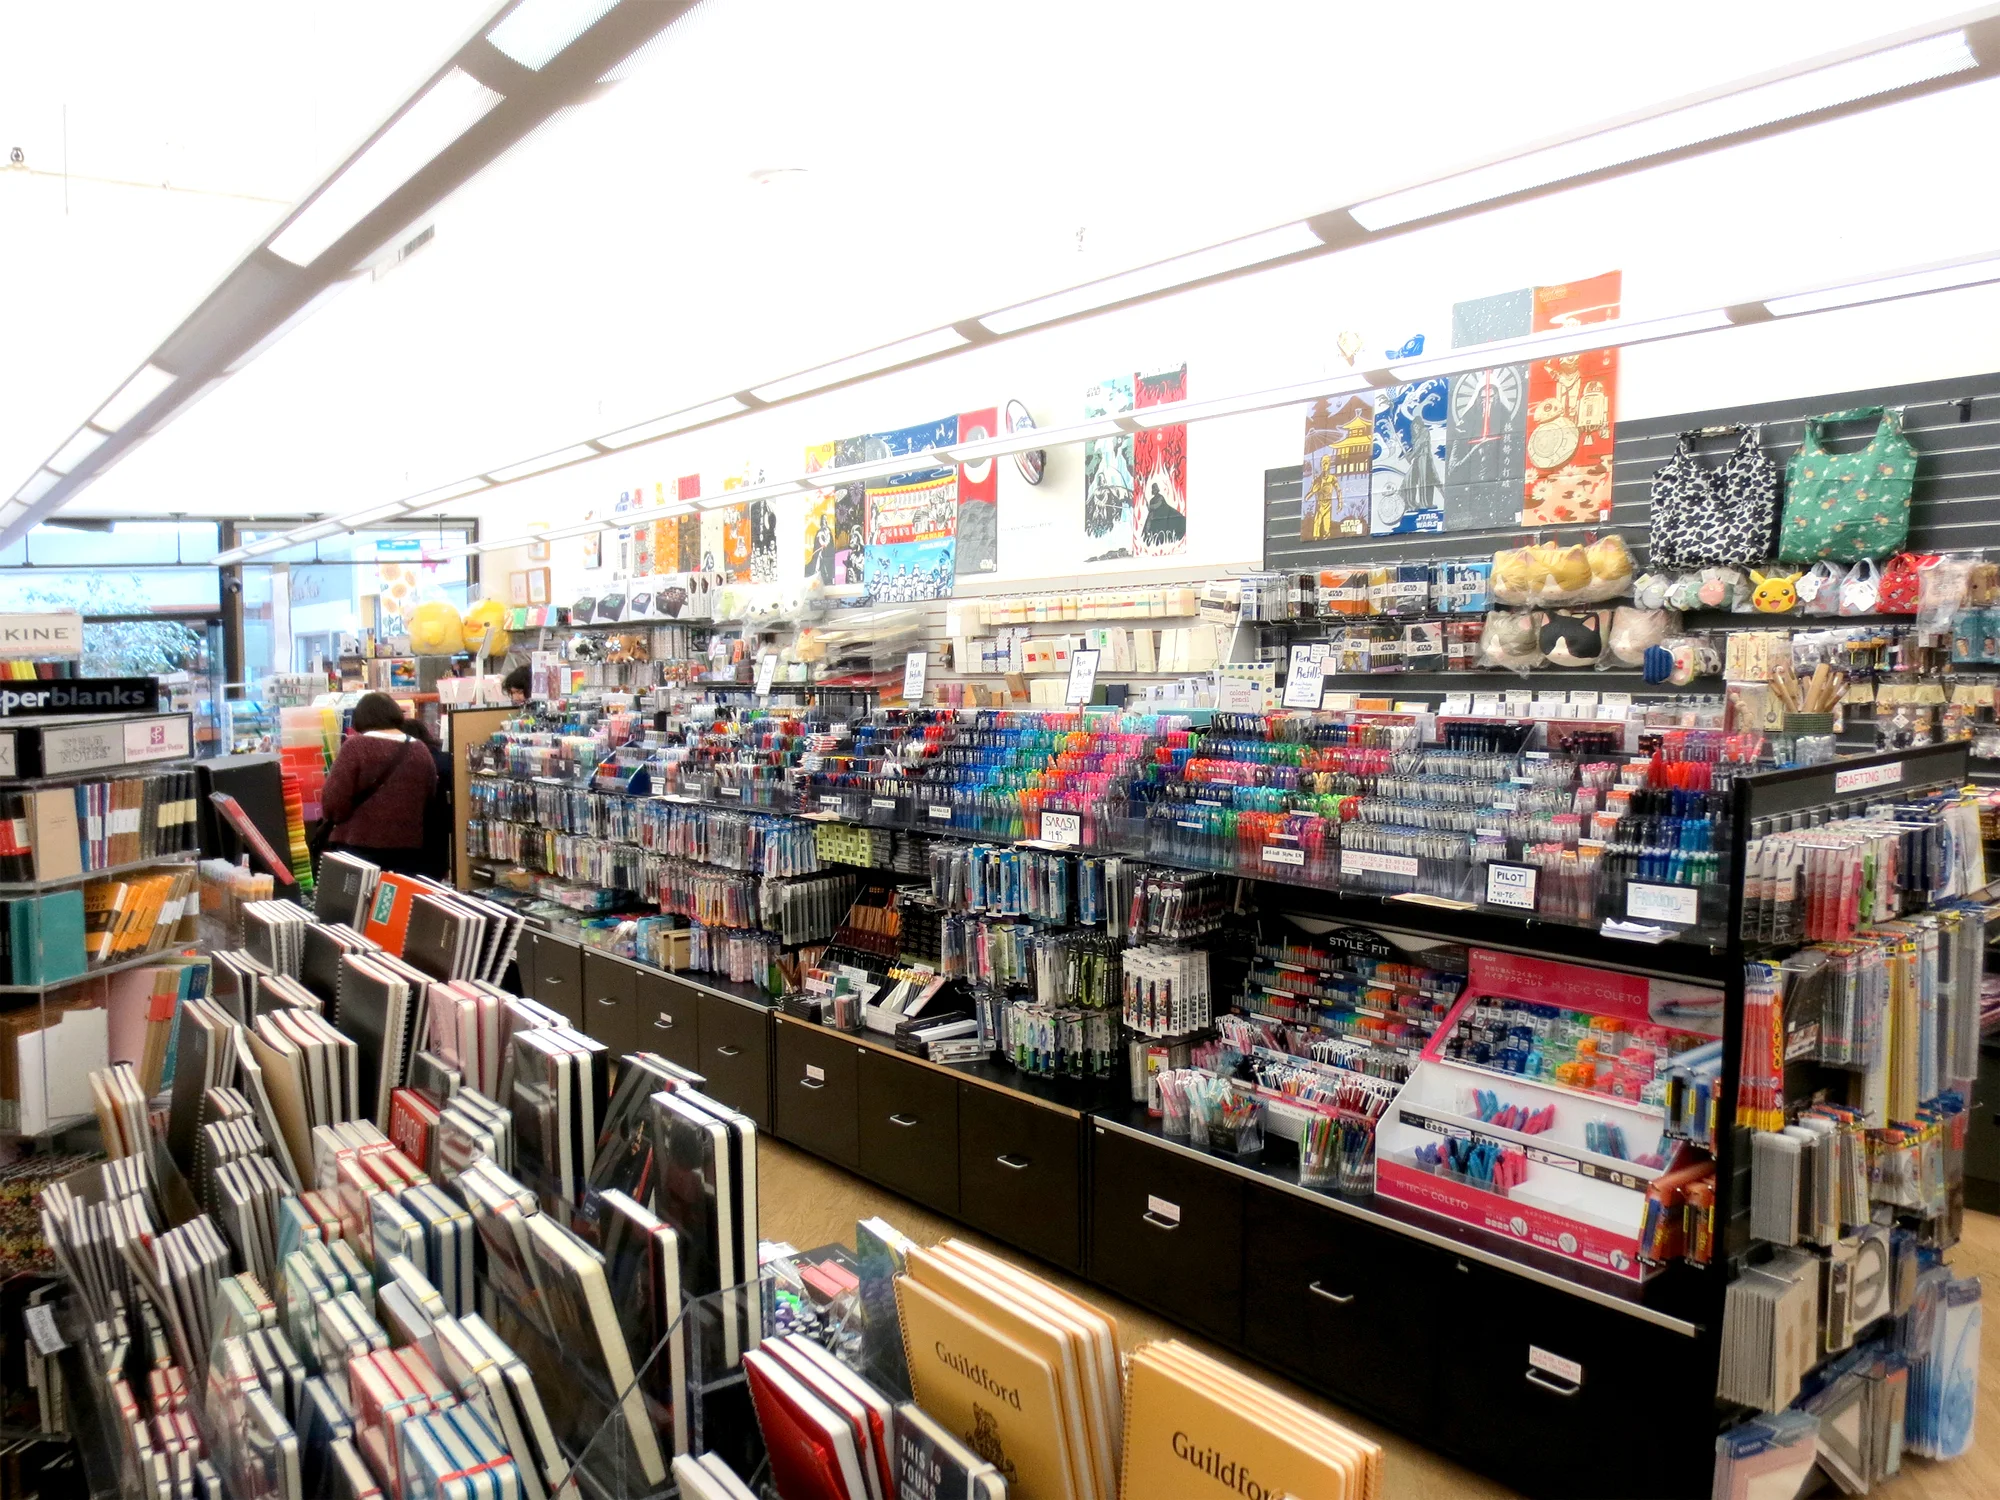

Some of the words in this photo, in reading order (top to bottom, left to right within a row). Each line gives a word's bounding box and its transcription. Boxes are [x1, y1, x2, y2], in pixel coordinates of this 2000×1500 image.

[1416, 513, 1439, 521] STAR
[1340, 525, 1358, 533] WAR
[0, 627, 69, 641] KINE
[1295, 650, 1310, 663] Pen
[0, 685, 145, 715] perblanks
[1837, 770, 1880, 788] DRAFTING
[1045, 815, 1077, 829] SARASA
[1497, 871, 1524, 882] PILOT
[1329, 936, 1364, 951] STYLE
[1371, 944, 1390, 956] FIT
[1479, 954, 1497, 962] PILOT
[1594, 987, 1642, 1005] COLETO
[1431, 1190, 1469, 1210] COLETO
[935, 1340, 1022, 1412] Guildford
[902, 1434, 926, 1470] THIS
[930, 1460, 942, 1485] IS
[901, 1457, 937, 1500] YOURS
